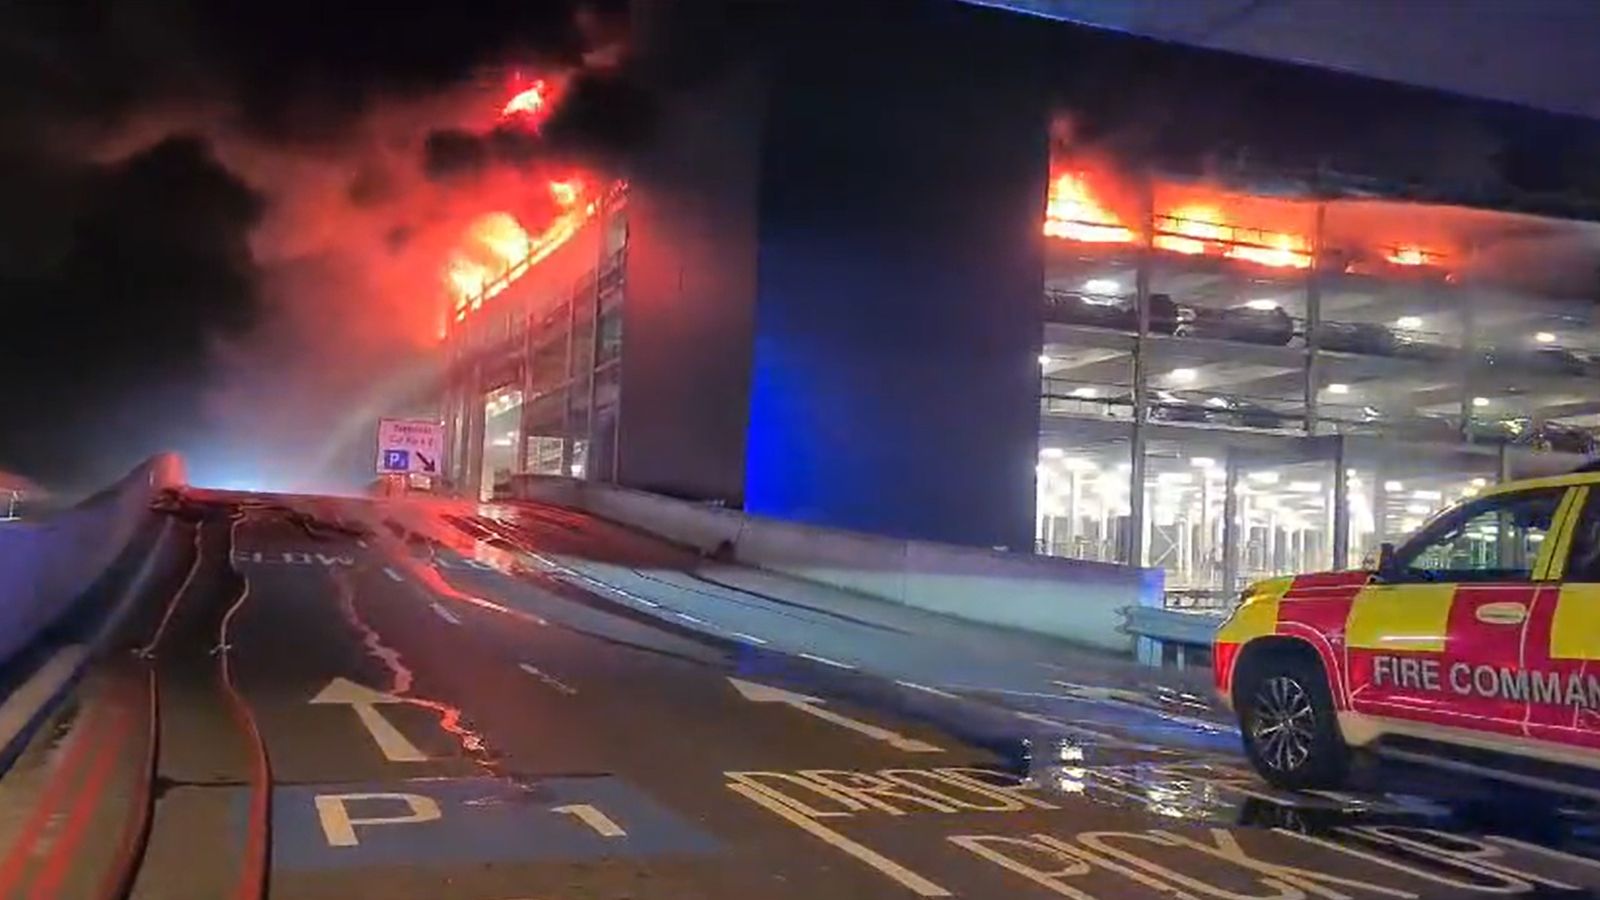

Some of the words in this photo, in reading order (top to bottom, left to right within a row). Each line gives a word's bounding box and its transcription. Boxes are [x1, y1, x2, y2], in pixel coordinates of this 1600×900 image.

[233, 551, 355, 566] SLOW
[1373, 656, 1442, 691] FIRE
[314, 793, 442, 847] P
[548, 803, 628, 838] 1
